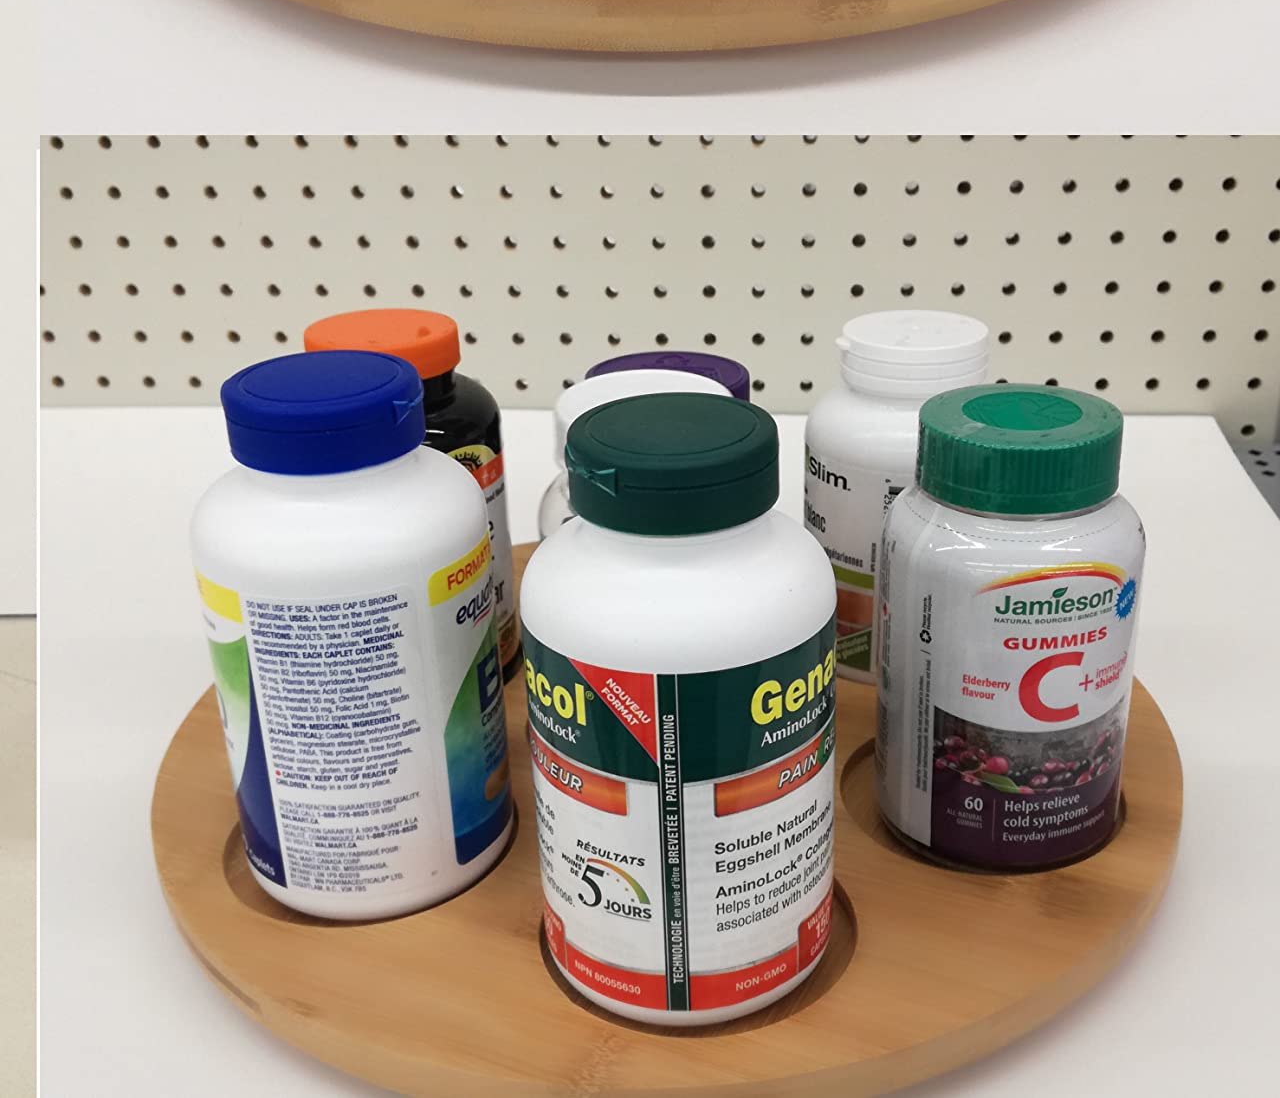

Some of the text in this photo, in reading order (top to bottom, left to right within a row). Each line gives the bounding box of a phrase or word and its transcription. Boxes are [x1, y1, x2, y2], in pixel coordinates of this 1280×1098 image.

[809, 456, 848, 490] Slim
[295, 605, 313, 613] SEAL
[315, 604, 341, 612] UNDER
[343, 601, 357, 610] CAP
[369, 594, 397, 606] BROKEN
[364, 602, 408, 616] maintenance
[995, 588, 1113, 616] Jamieson
[352, 620, 370, 628] blood
[1035, 616, 1072, 624] SOURCES
[1078, 612, 1097, 620] SINCE
[351, 626, 390, 638] caplet daily
[363, 631, 404, 644] MEDICINAL
[1003, 626, 1107, 651] GUMMIES
[325, 649, 353, 658] CAPLET
[525, 658, 586, 726] acol
[751, 650, 836, 725] Gena
[962, 674, 1010, 691] Elderberry
[1018, 652, 1084, 723] C
[1095, 671, 1120, 690] shield
[606, 678, 651, 724] NOUVEAU
[962, 687, 995, 700] flavour
[528, 694, 576, 744] minoLock
[601, 688, 639, 726] FORMAT
[352, 714, 400, 728] INGREDIENTS
[761, 695, 827, 747] AminoLock
[663, 715, 675, 762] PENDING
[778, 750, 818, 788] PAIN
[665, 765, 677, 801] PATENT
[964, 797, 983, 811] 60
[1003, 805, 1088, 828] cold symptoms
[1004, 794, 1080, 814] Helps relieve
[664, 814, 679, 864] BREVETÉE
[715, 799, 818, 855] Soluble Natural
[716, 801, 831, 873] Eggshell Membrane
[1003, 831, 1046, 843] Everyday
[1048, 822, 1082, 839] immune
[561, 853, 582, 871] MOINS
[575, 854, 585, 864] EN
[576, 839, 645, 867] RÉSULTATS
[570, 867, 579, 877] DE
[578, 865, 604, 907] 5
[716, 895, 750, 915] Helps
[755, 893, 765, 904] to
[769, 873, 801, 900] reduce
[803, 862, 819, 885] joint
[604, 901, 652, 920] JOURS
[675, 910, 681, 918] en
[717, 888, 801, 932] associated with
[672, 920, 684, 984] TECHNOLOGIE
[574, 959, 592, 978] NPN
[735, 963, 787, 991] NON-GMO
